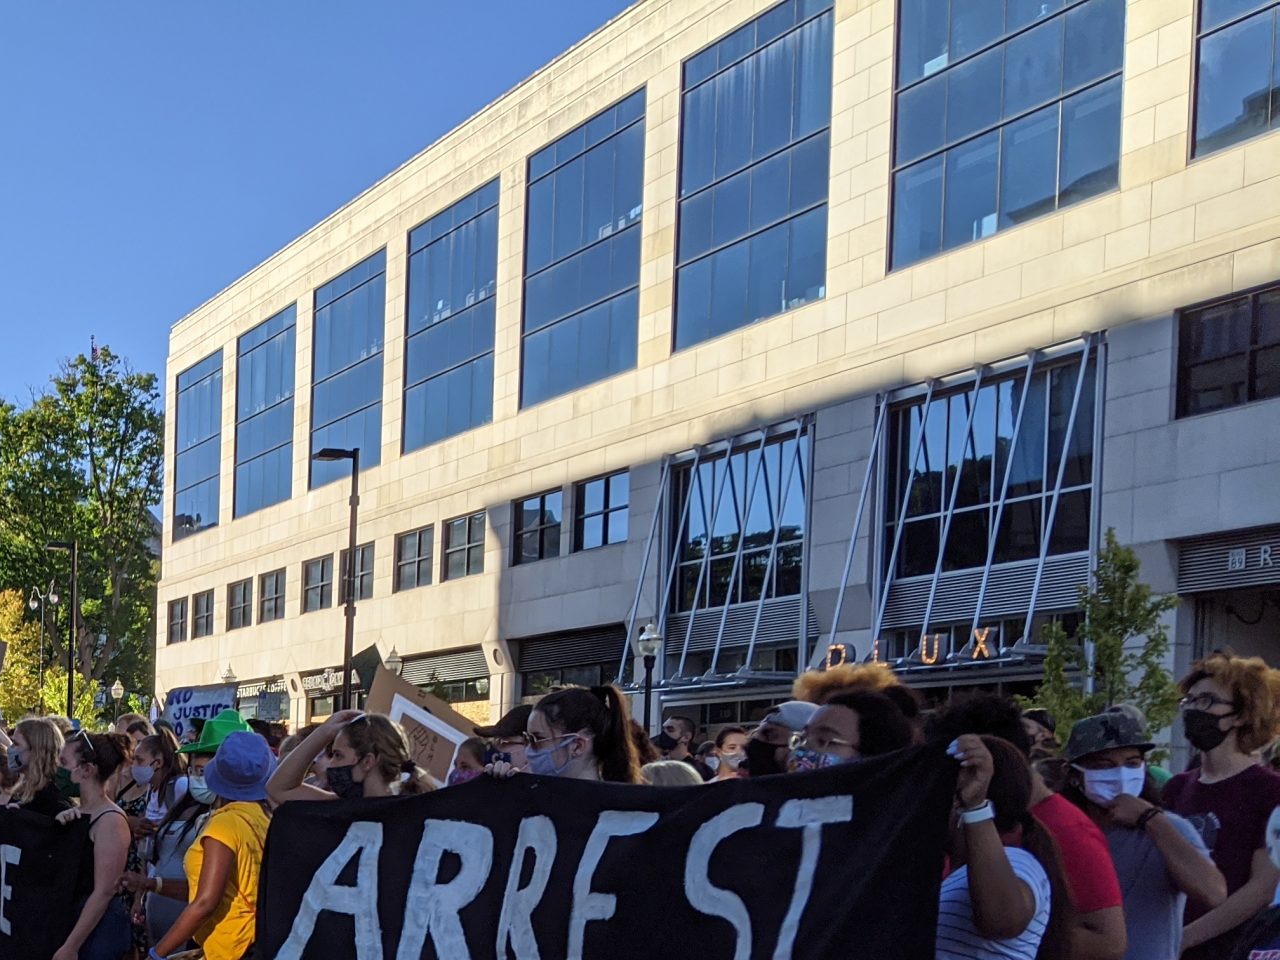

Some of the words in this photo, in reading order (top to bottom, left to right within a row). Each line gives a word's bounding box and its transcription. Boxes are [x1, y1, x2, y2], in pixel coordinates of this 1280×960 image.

[826, 626, 998, 673] DLUX
[169, 689, 193, 706] NO
[173, 703, 230, 720] JUSTIC
